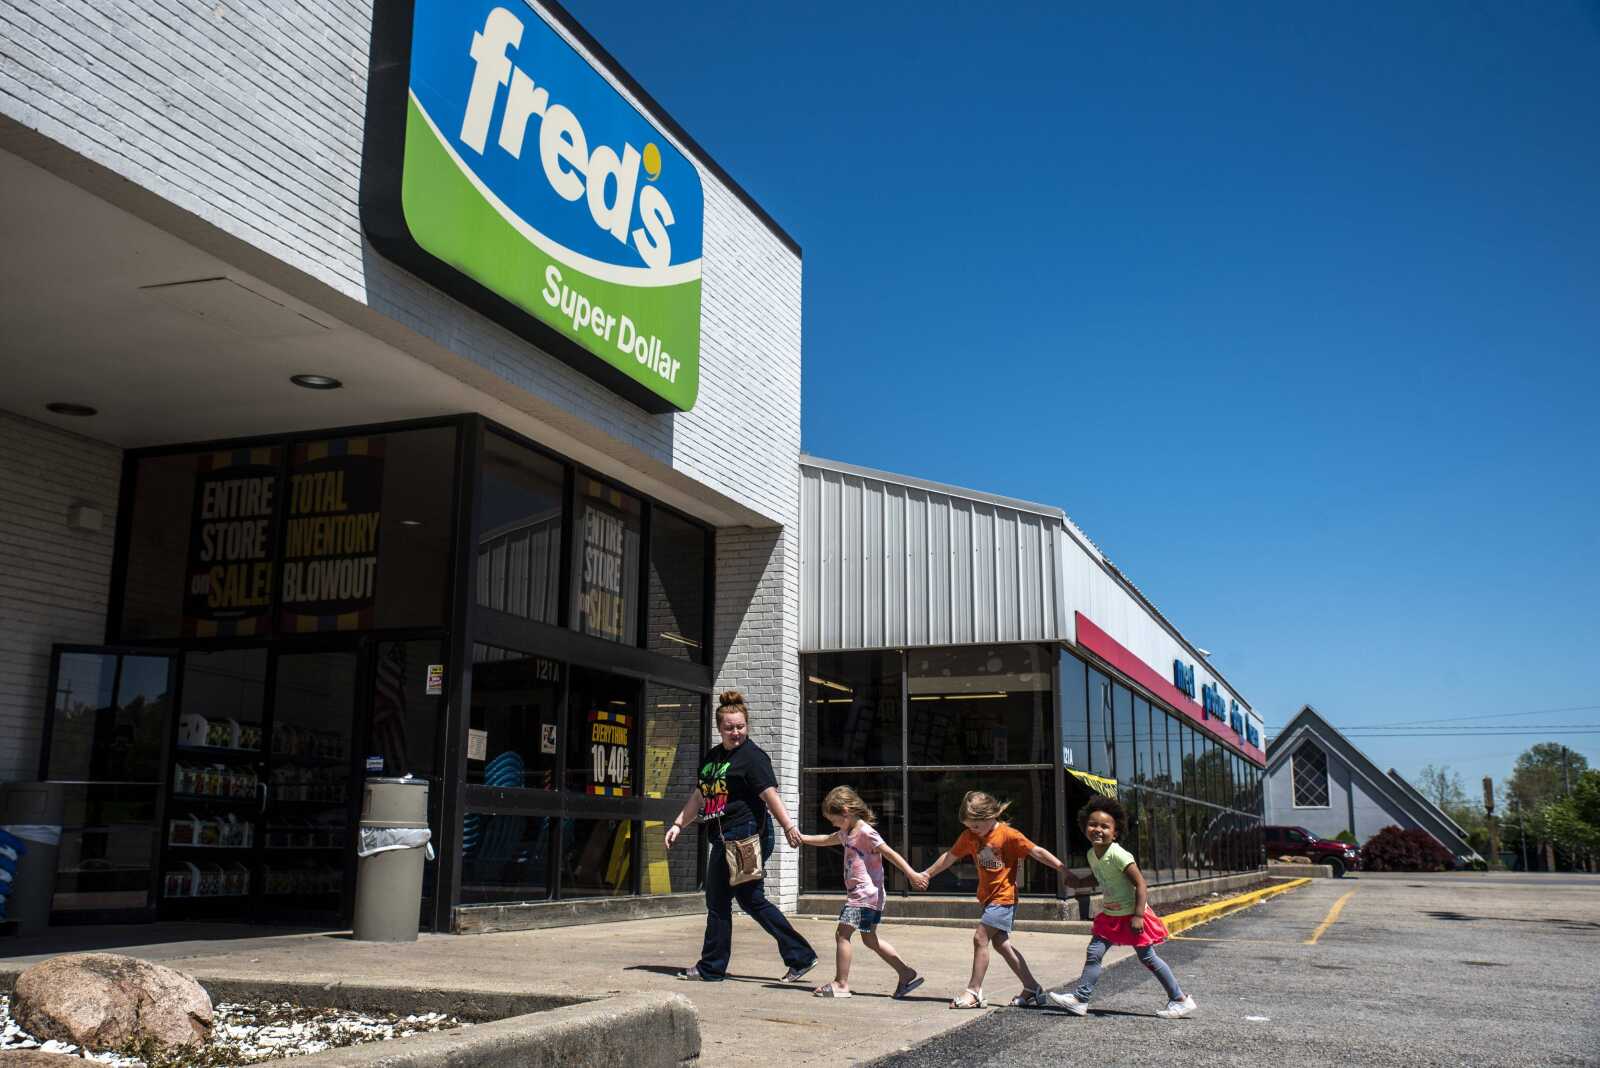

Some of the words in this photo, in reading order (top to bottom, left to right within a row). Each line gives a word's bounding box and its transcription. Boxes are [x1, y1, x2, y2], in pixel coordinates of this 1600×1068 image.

[460, 7, 675, 269] fred's
[542, 265, 617, 342] Super
[616, 314, 680, 384] Dollar
[201, 476, 275, 520] ENTIRE
[289, 470, 348, 513] TOTAL
[200, 518, 270, 562] STORE
[284, 512, 381, 558] INVENTORY
[585, 504, 624, 555] ENTIRE
[207, 561, 274, 608] SALE!
[281, 556, 377, 603] BLOWOUT
[584, 546, 621, 593] STORE
[591, 722, 628, 746] EVERYTHING
